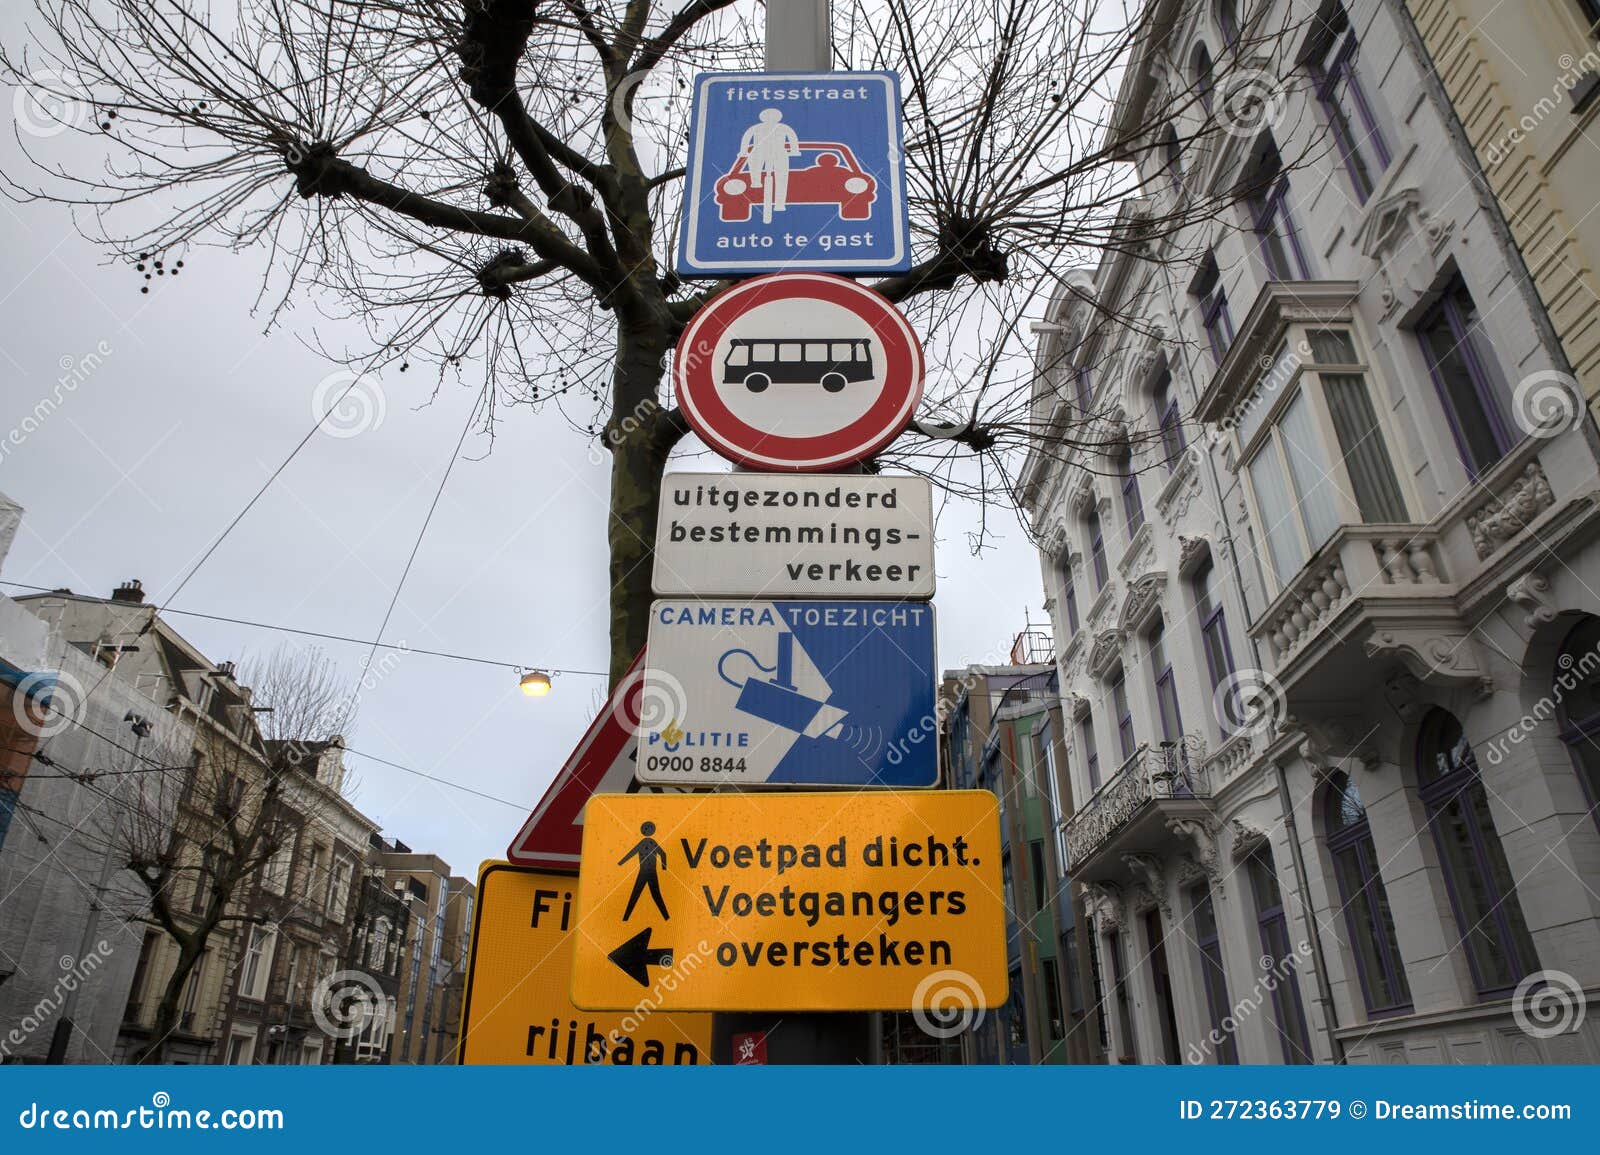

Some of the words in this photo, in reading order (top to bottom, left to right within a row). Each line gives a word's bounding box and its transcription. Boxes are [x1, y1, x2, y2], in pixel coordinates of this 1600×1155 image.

[726, 86, 869, 101] fietsstraat
[716, 233, 774, 248] auto
[783, 232, 809, 247] te
[818, 231, 874, 252] gast
[673, 485, 898, 513] uitgezonderd
[670, 520, 920, 551] bestemmings-
[786, 558, 921, 582] verkeer
[659, 607, 776, 626] CAMERA
[788, 608, 925, 627] TOEZICHT
[646, 755, 694, 772] 0900
[699, 756, 747, 773] 8844
[680, 835, 847, 876] Voetpad
[862, 834, 981, 868] dicht.
[702, 885, 967, 927] Voetgangers
[716, 932, 952, 967] oversteken
[525, 1018, 699, 1065] rijbaan
